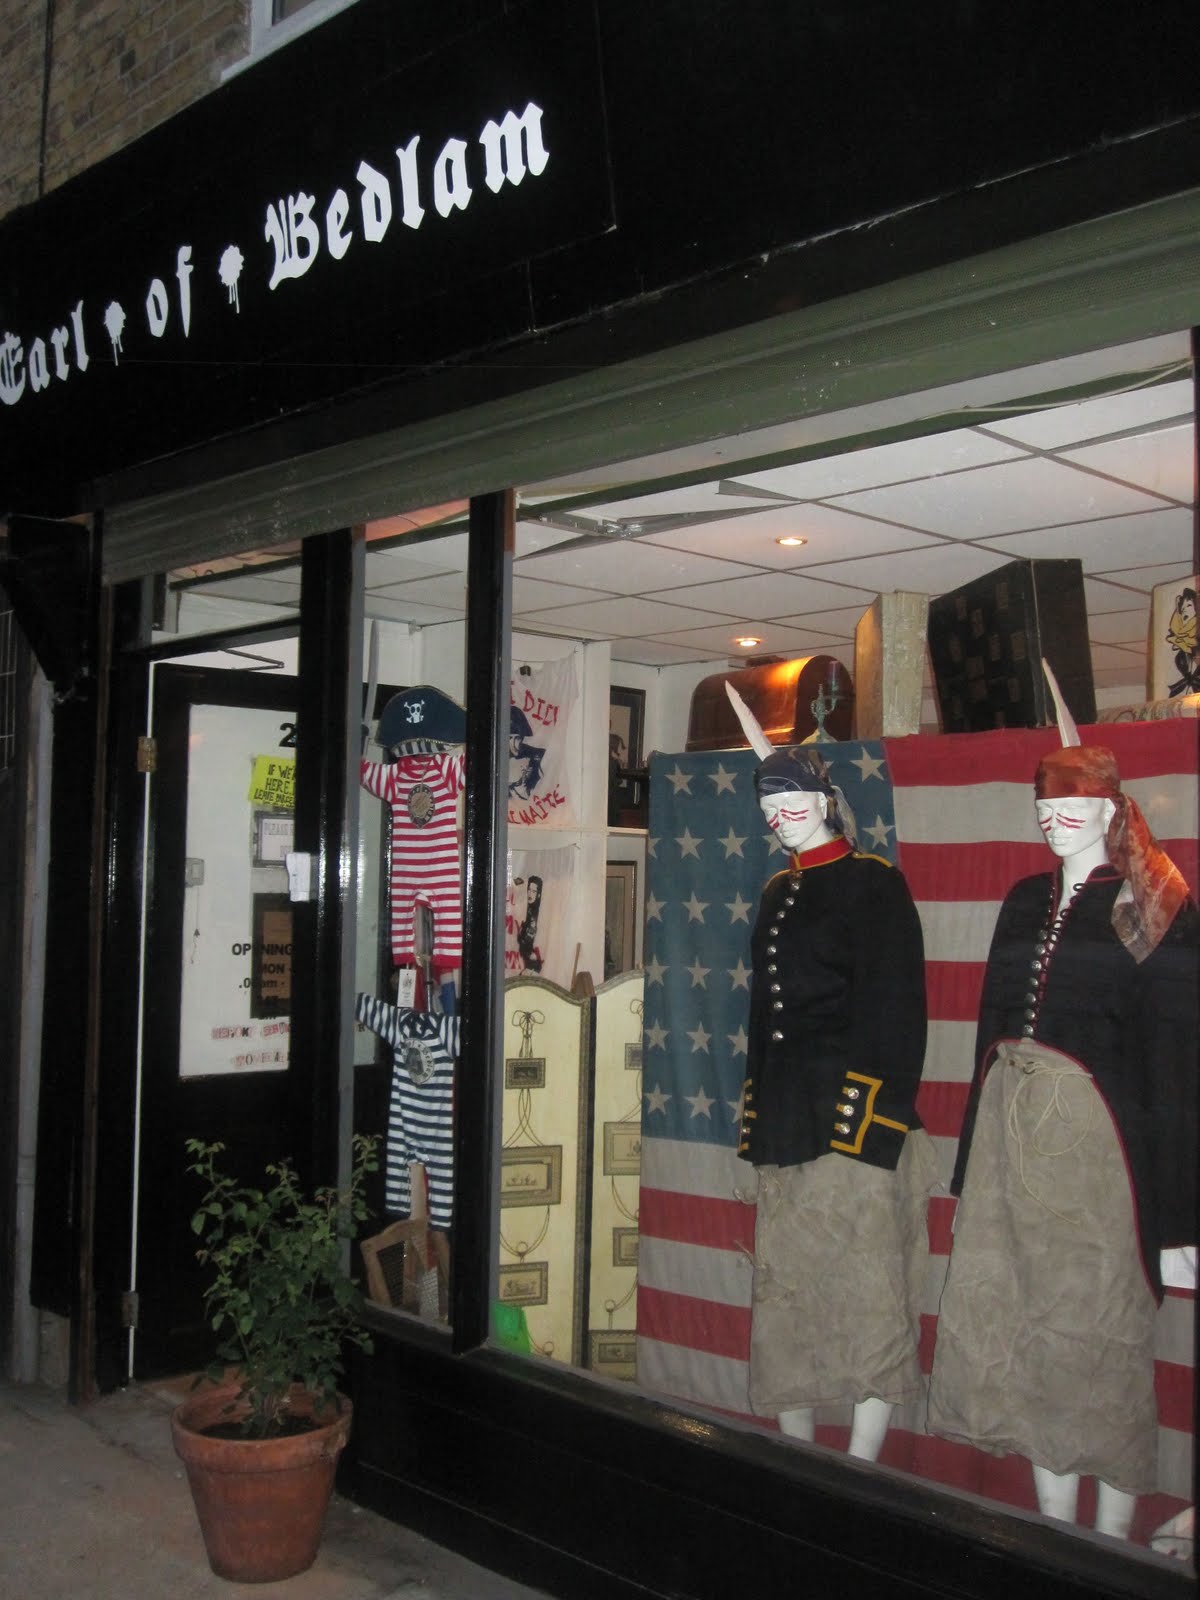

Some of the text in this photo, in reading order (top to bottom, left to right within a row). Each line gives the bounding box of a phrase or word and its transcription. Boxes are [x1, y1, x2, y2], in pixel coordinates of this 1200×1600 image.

[0, 102, 550, 405] Earl of Bedlam
[231, 943, 293, 957] OPNING
